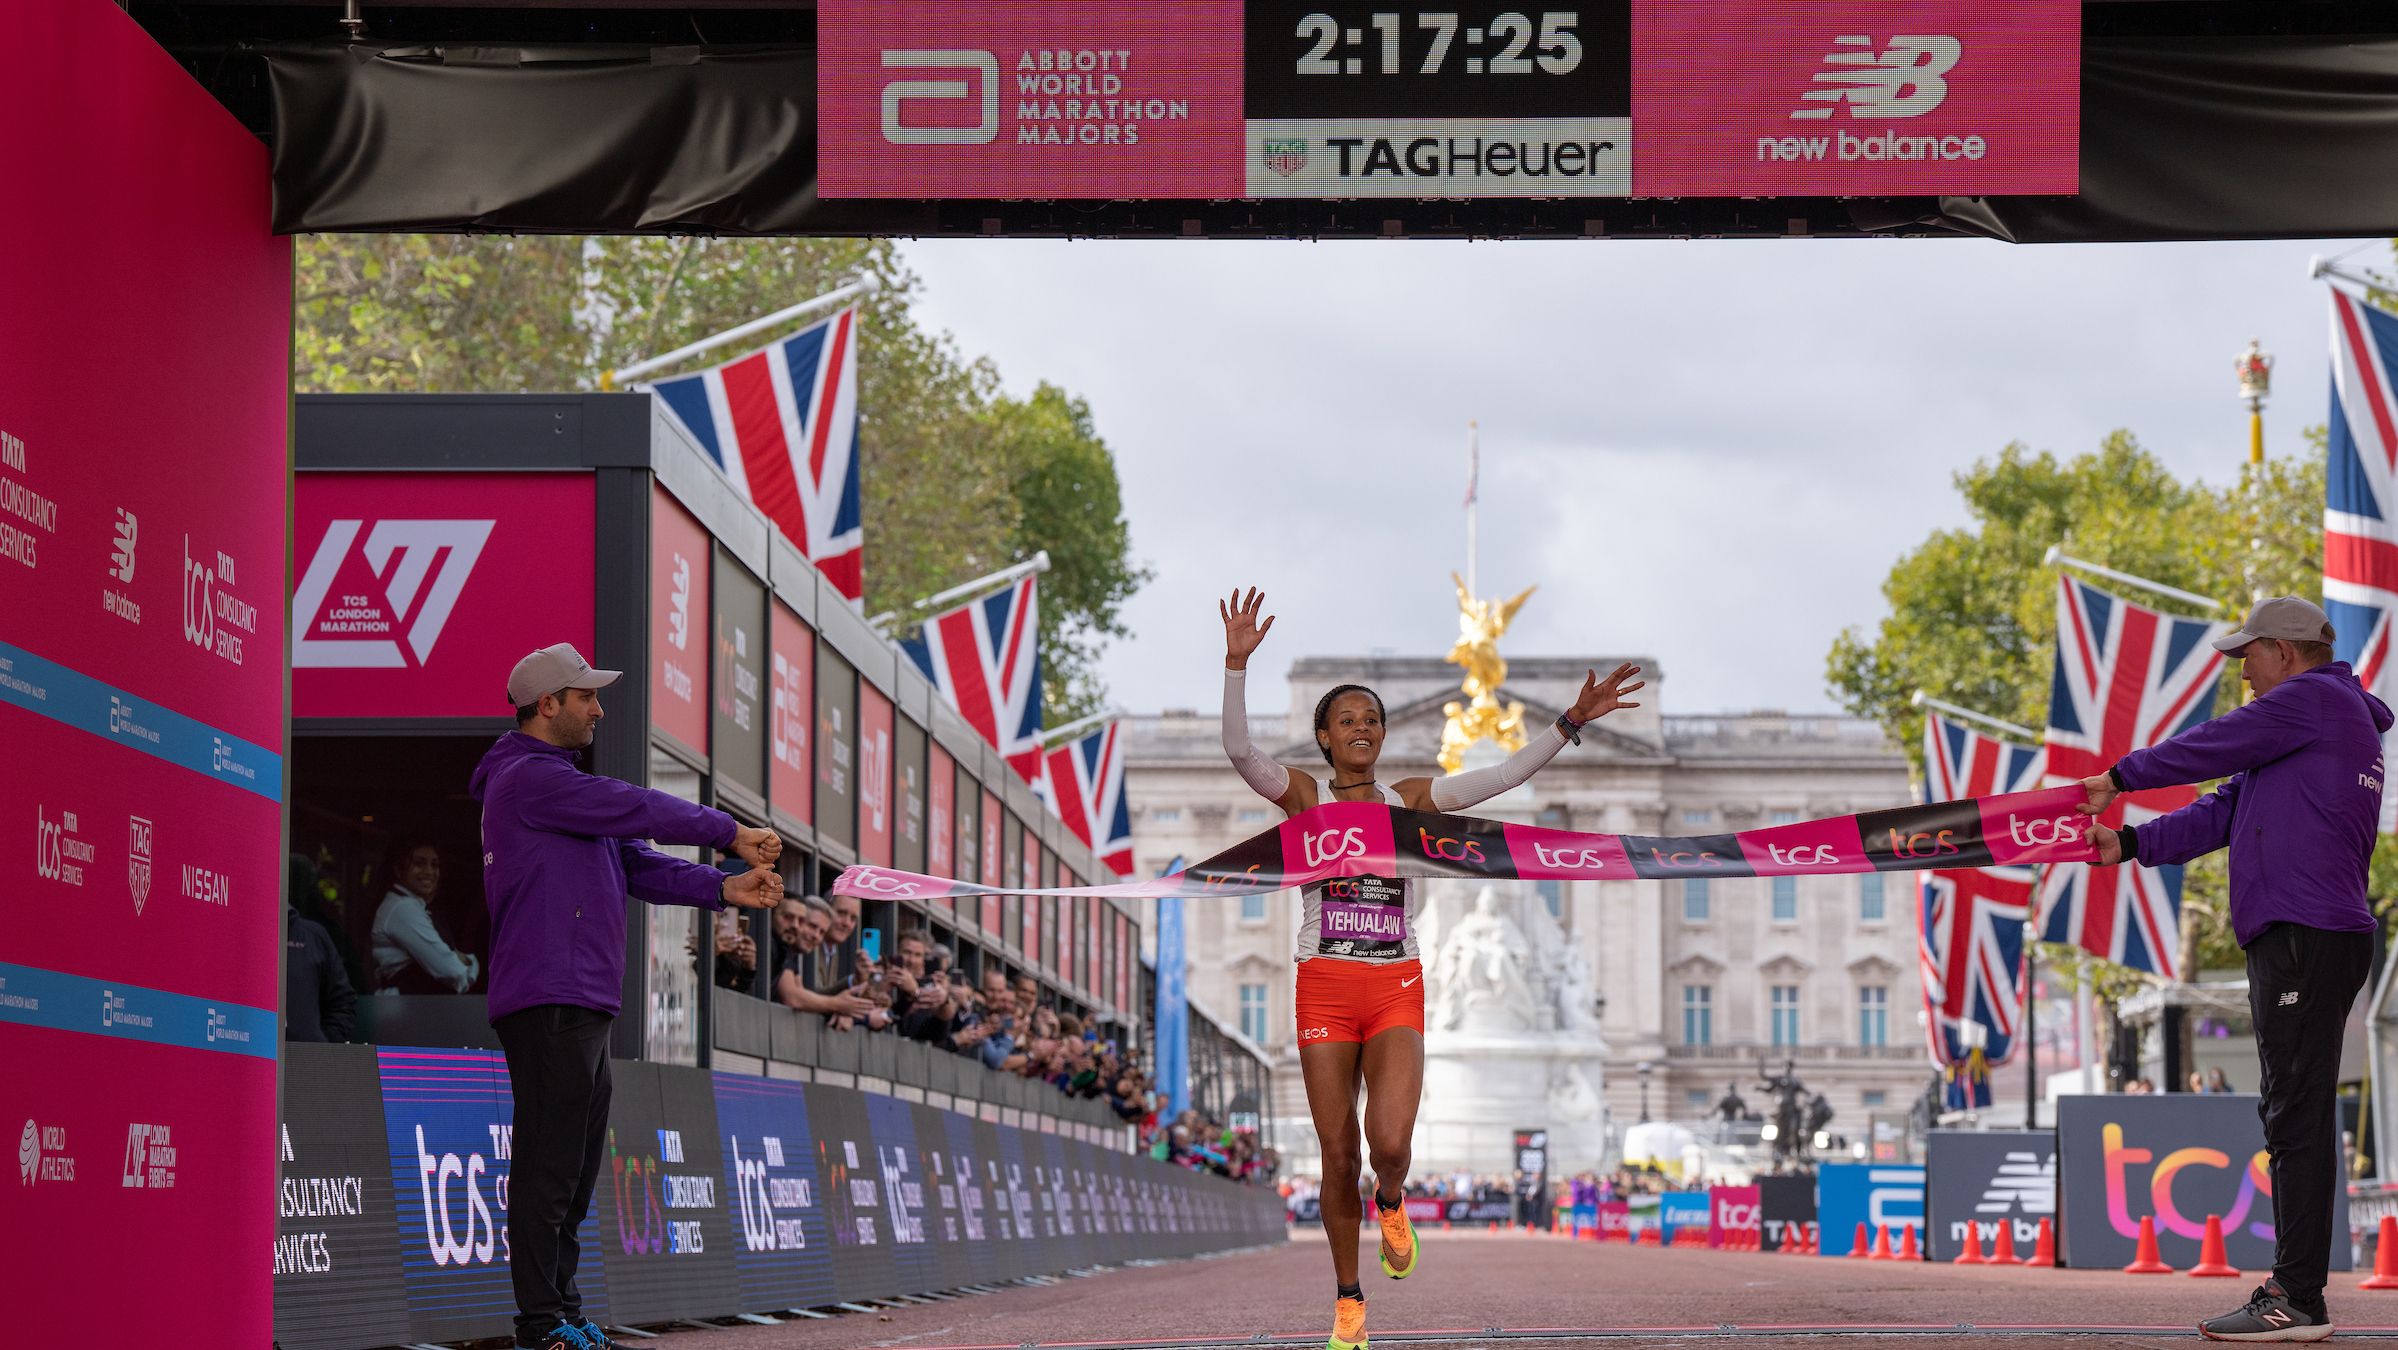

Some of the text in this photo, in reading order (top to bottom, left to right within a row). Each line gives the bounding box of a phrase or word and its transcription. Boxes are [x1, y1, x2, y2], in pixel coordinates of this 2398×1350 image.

[1296, 12, 1583, 75] 2:17:25
[1017, 50, 1131, 71] ABBOTT
[1017, 74, 1122, 95] WORLD
[1017, 100, 1189, 120] MARATHON
[1017, 125, 1139, 145] MAJORS
[1757, 130, 1987, 161] new balance
[1, 430, 26, 474] TATA
[0, 476, 57, 534] CONSULTANCY
[0, 521, 36, 569] SERVICES
[216, 550, 235, 586] TATA
[103, 589, 141, 625] new balance
[183, 533, 213, 651] tcs
[342, 595, 368, 607] TCS
[216, 590, 257, 635] CONSULTANCY
[320, 621, 389, 633] MARATHON
[329, 608, 380, 620] LONDON
[215, 628, 242, 667] SERVICES
[2358, 772, 2382, 794] new
[63, 811, 78, 833] TATA
[2009, 813, 2078, 847] tcs
[37, 804, 61, 881] tcs
[62, 837, 95, 864] CONSULTANCY
[132, 823, 150, 855] TAG
[1303, 826, 1366, 868] tcs
[1419, 827, 1486, 864] tcs
[1889, 827, 1960, 859] tcs
[1533, 842, 1604, 869] tcs
[1650, 847, 1723, 868] tcs
[1768, 843, 1840, 866] tcs
[61, 864, 83, 887] SERVICES
[181, 864, 229, 907] NISSAN
[854, 867, 921, 897] tcs
[1329, 880, 1359, 898] tcs
[1362, 886, 1402, 896] CONSULTANCY
[1326, 911, 1401, 935] YEHUALAW
[1370, 948, 1398, 957] balance
[1299, 1027, 1328, 1040] NEOS
[42, 1126, 65, 1151] WORLD
[150, 1124, 171, 1146] LONDON
[657, 1129, 684, 1163] TATA
[149, 1146, 176, 1168] MARATHON
[762, 1137, 785, 1167] TATA
[148, 1167, 167, 1189] EVENTS
[609, 1128, 663, 1255] tcs
[662, 1174, 715, 1209] CONSULTANCY
[732, 1135, 775, 1251] tcs
[281, 1176, 363, 1217] SULTANCY
[415, 1124, 494, 1266] tcs
[666, 1220, 704, 1254] SERVICES
[775, 1219, 805, 1249] SERVICES
[1951, 1222, 2000, 1242] nw
[273, 1232, 331, 1274] RVICES
